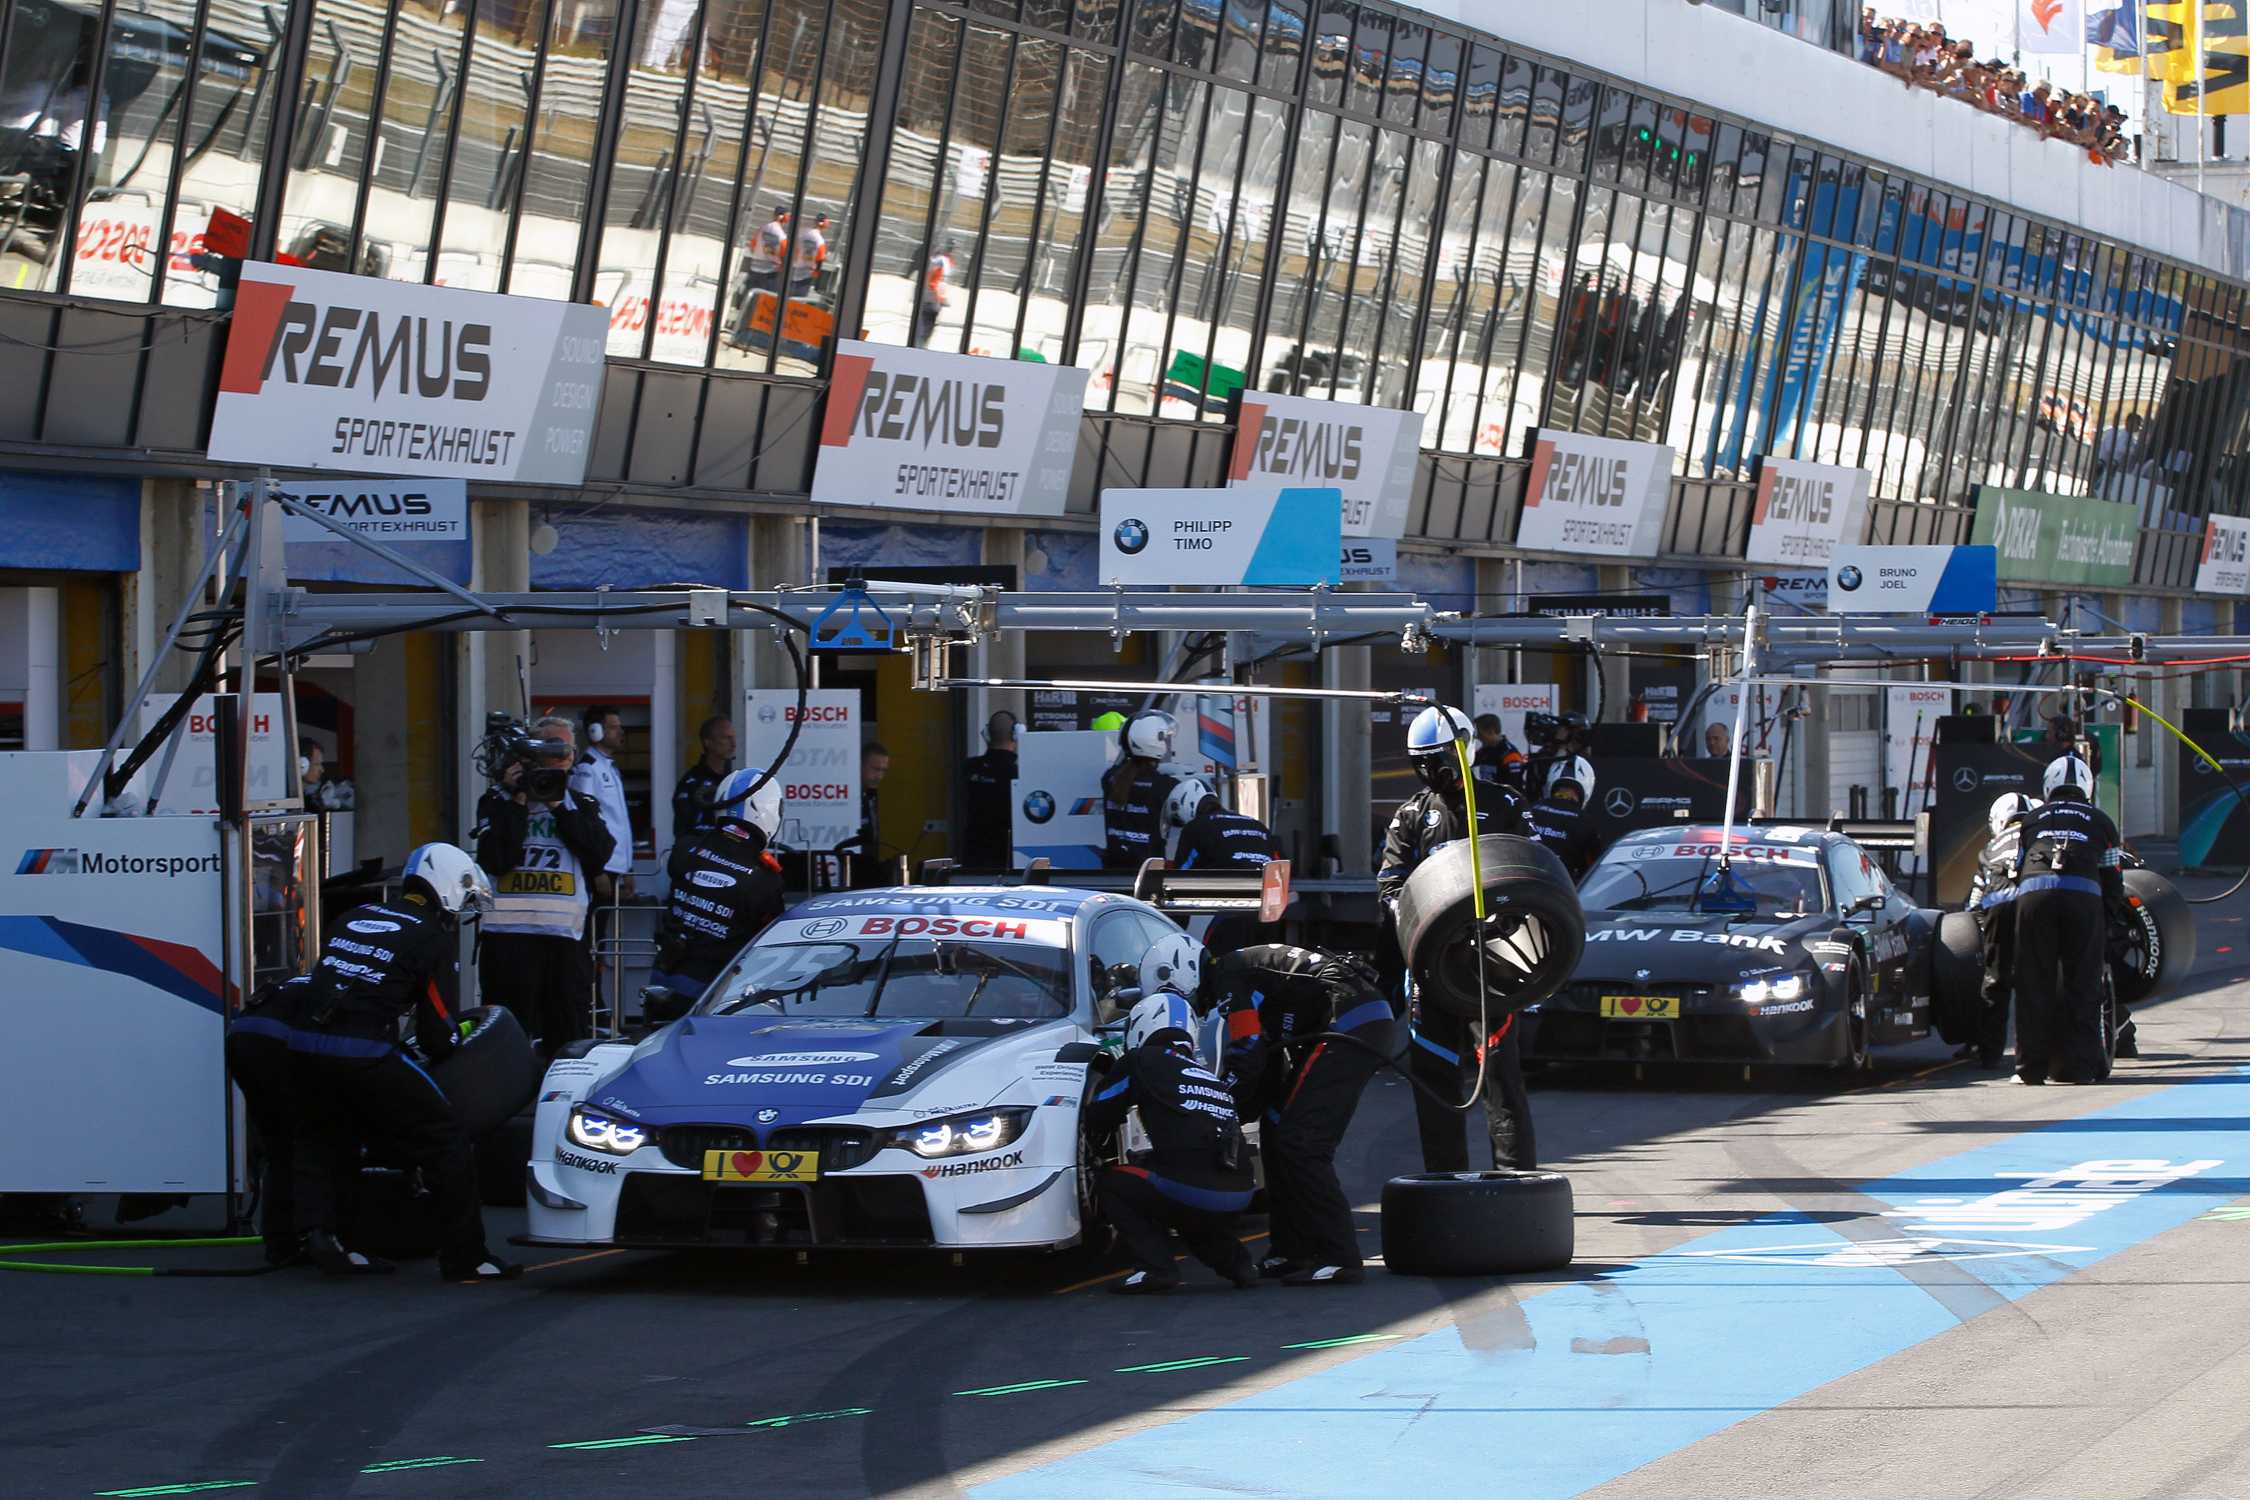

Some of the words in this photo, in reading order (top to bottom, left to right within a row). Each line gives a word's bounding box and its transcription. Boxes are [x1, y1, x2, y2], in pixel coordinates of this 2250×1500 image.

[260, 302, 492, 402] REMUS
[850, 370, 1005, 450] REMUS
[332, 417, 515, 466] SPORTEXHAUST
[1249, 416, 1363, 481] REMUS
[896, 464, 1019, 500] SPORTEXHAUST
[1545, 451, 1627, 509] REMUS
[1765, 475, 1833, 524] REMUS
[327, 520, 459, 533] ORTEXHAUST
[1174, 520, 1232, 533] PHILIPP
[1174, 538, 1213, 550] TIMO
[2210, 528, 2247, 562] REMUS
[1340, 567, 1392, 577] EXHAUST
[1879, 568, 1917, 577] BRUNO
[1776, 578, 1828, 590] REM
[1879, 580, 1907, 589] JOEL
[1503, 696, 1550, 709] BOSCH
[1909, 691, 1944, 701] BOSCH
[784, 706, 849, 722] BOSCH
[190, 715, 270, 733] BOH
[787, 748, 849, 767] DTM
[192, 765, 270, 787] DM
[784, 784, 849, 799] BOSCH
[82, 853, 221, 877] Motorsport
[511, 873, 564, 893] ADAC
[807, 896, 992, 911] SAMSUNG
[997, 898, 1063, 912] SDI
[859, 917, 1027, 939] BOSCH
[1585, 929, 1660, 942] MW
[1670, 929, 1787, 955] Bank
[749, 1053, 858, 1064] SAMSUNG
[704, 1072, 824, 1087] SAMSUNG
[829, 1073, 873, 1087] SDI
[1178, 1083, 1230, 1103] SAMSUNG
